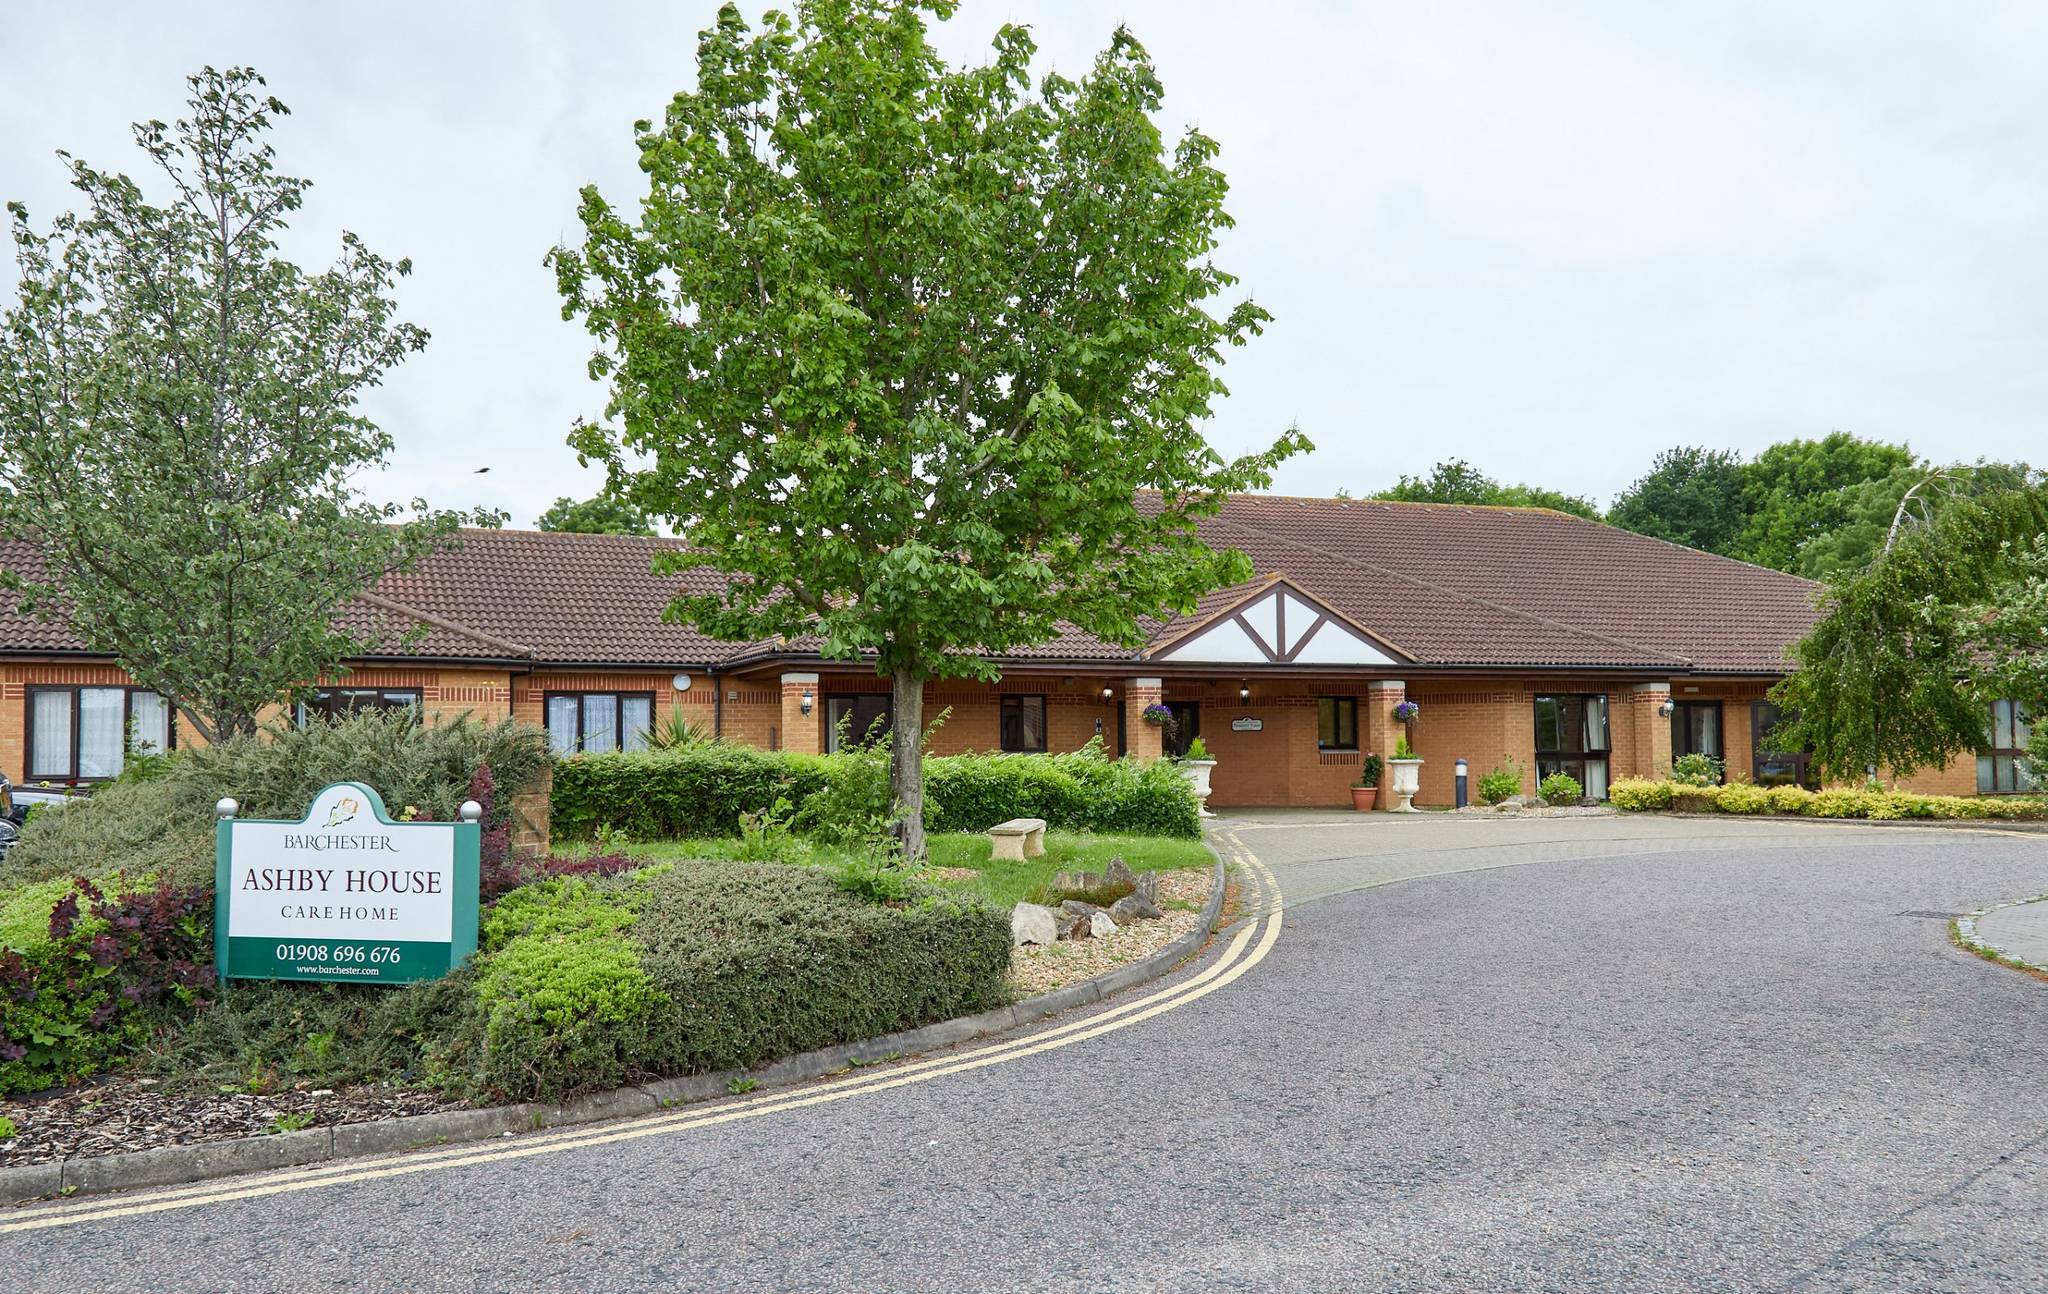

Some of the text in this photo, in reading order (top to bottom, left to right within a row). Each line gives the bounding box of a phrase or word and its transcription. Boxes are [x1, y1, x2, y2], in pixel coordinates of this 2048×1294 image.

[284, 834, 400, 851] BARCHESTER
[243, 868, 441, 894] ASHBY HOUSE
[281, 905, 398, 920] CARE HOME
[276, 944, 401, 963] 01908 696 676
[296, 965, 379, 976] www.barchester.com
